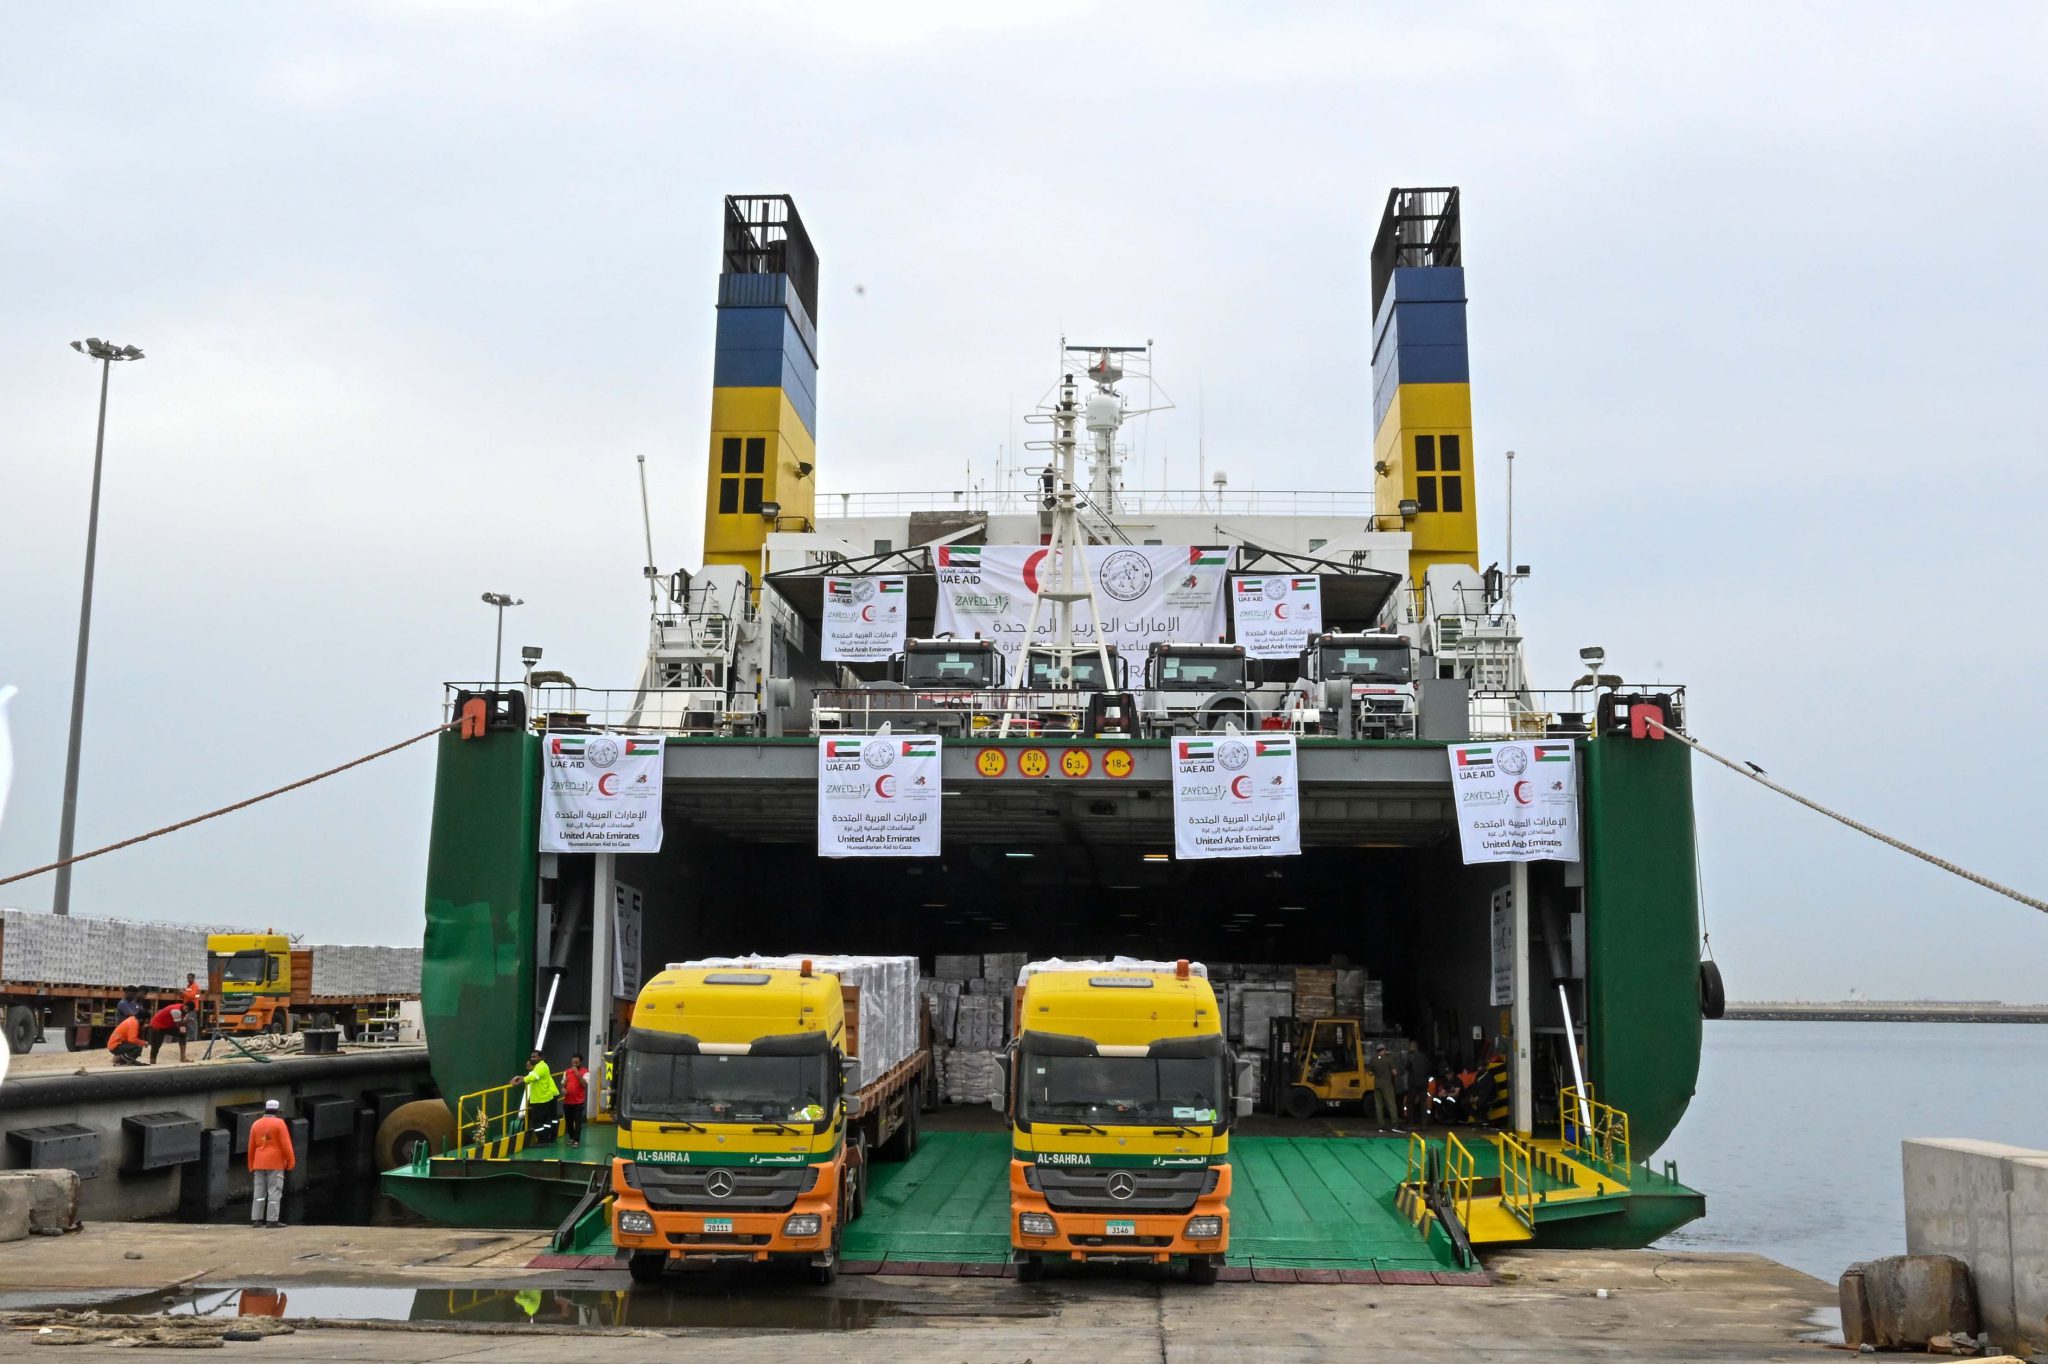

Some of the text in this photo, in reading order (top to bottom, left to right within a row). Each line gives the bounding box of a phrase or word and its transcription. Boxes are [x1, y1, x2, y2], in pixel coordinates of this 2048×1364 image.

[940, 574, 981, 584] UAE AID
[955, 596, 986, 606] ZAYED
[1124, 617, 1180, 637] الإمارات
[826, 784, 852, 793] ZAYED
[1181, 787, 1207, 795] ZAYED
[1464, 792, 1490, 801] ZAYED
[556, 810, 646, 821] الإمارات العربية المتحدة
[832, 813, 926, 824] الإمارات العربية المتحدة
[1189, 812, 1285, 824] الإمارات العربية المتحدة
[1474, 818, 1566, 828] الإمارات العربية المتحدة
[1196, 837, 1222, 845] United
[637, 1151, 690, 1163] AL-SAHRAA
[750, 1155, 804, 1164] الصحراء
[1037, 1153, 1091, 1164] AL-SAHRAA
[1153, 1157, 1206, 1166] الصحراء
